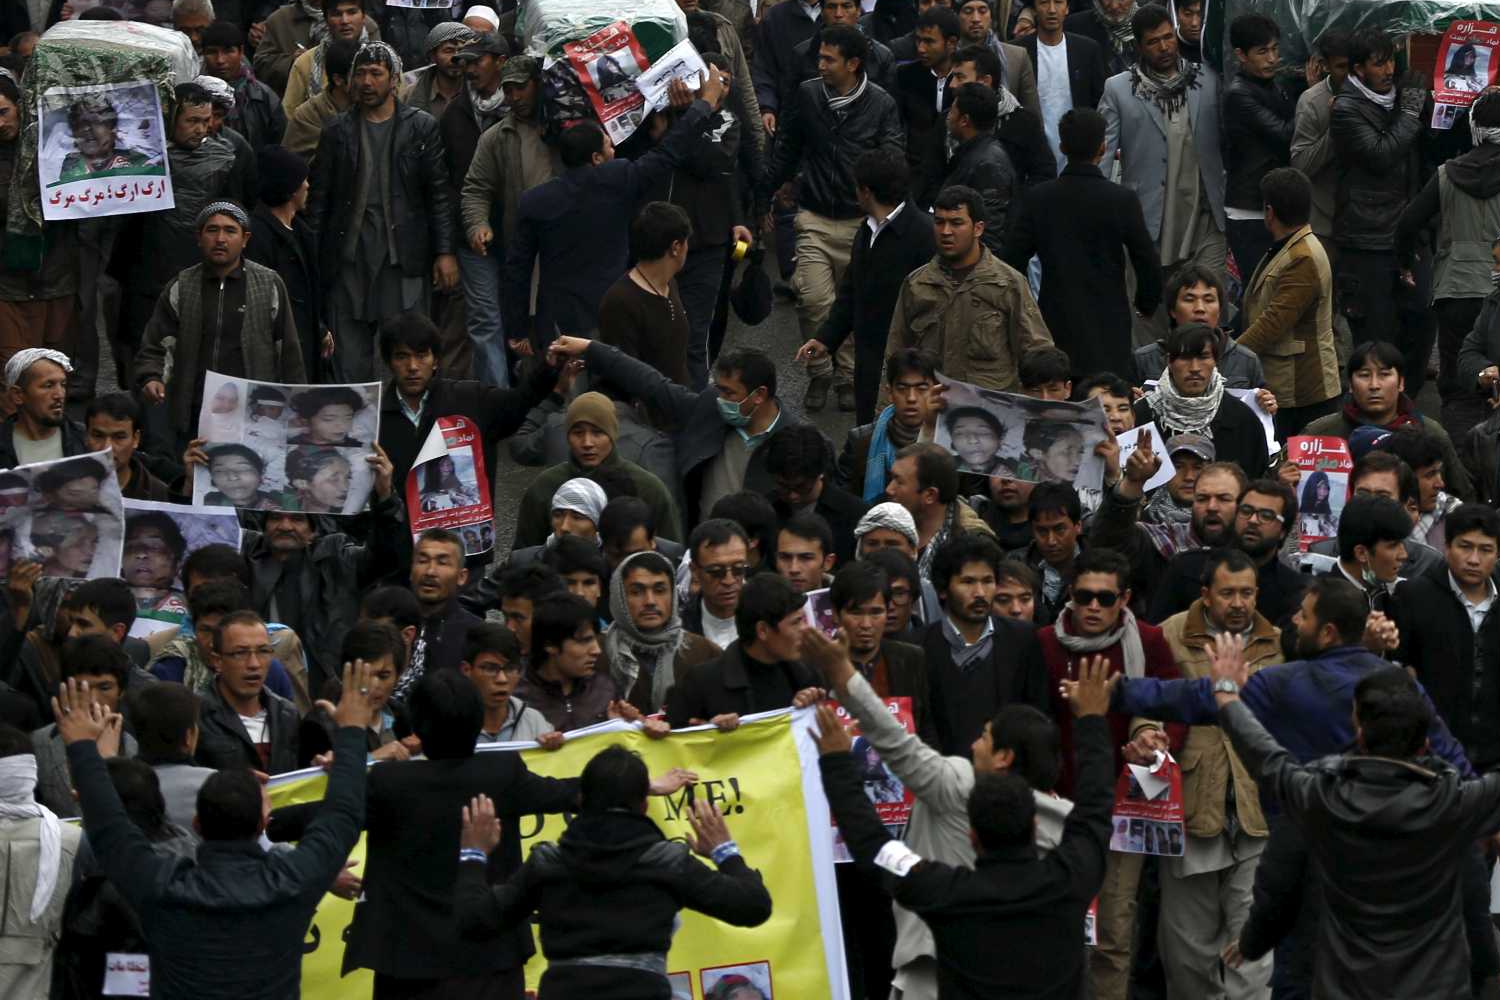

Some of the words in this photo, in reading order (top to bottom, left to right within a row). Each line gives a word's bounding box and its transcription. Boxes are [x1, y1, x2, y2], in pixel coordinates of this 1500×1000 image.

[1457, 23, 1498, 34] هزاره
[142, 179, 166, 198] ارگ
[49, 192, 76, 208] مرگ
[78, 190, 105, 206] مرگ
[1300, 438, 1346, 455] هزاره
[664, 777, 744, 822] ME!
